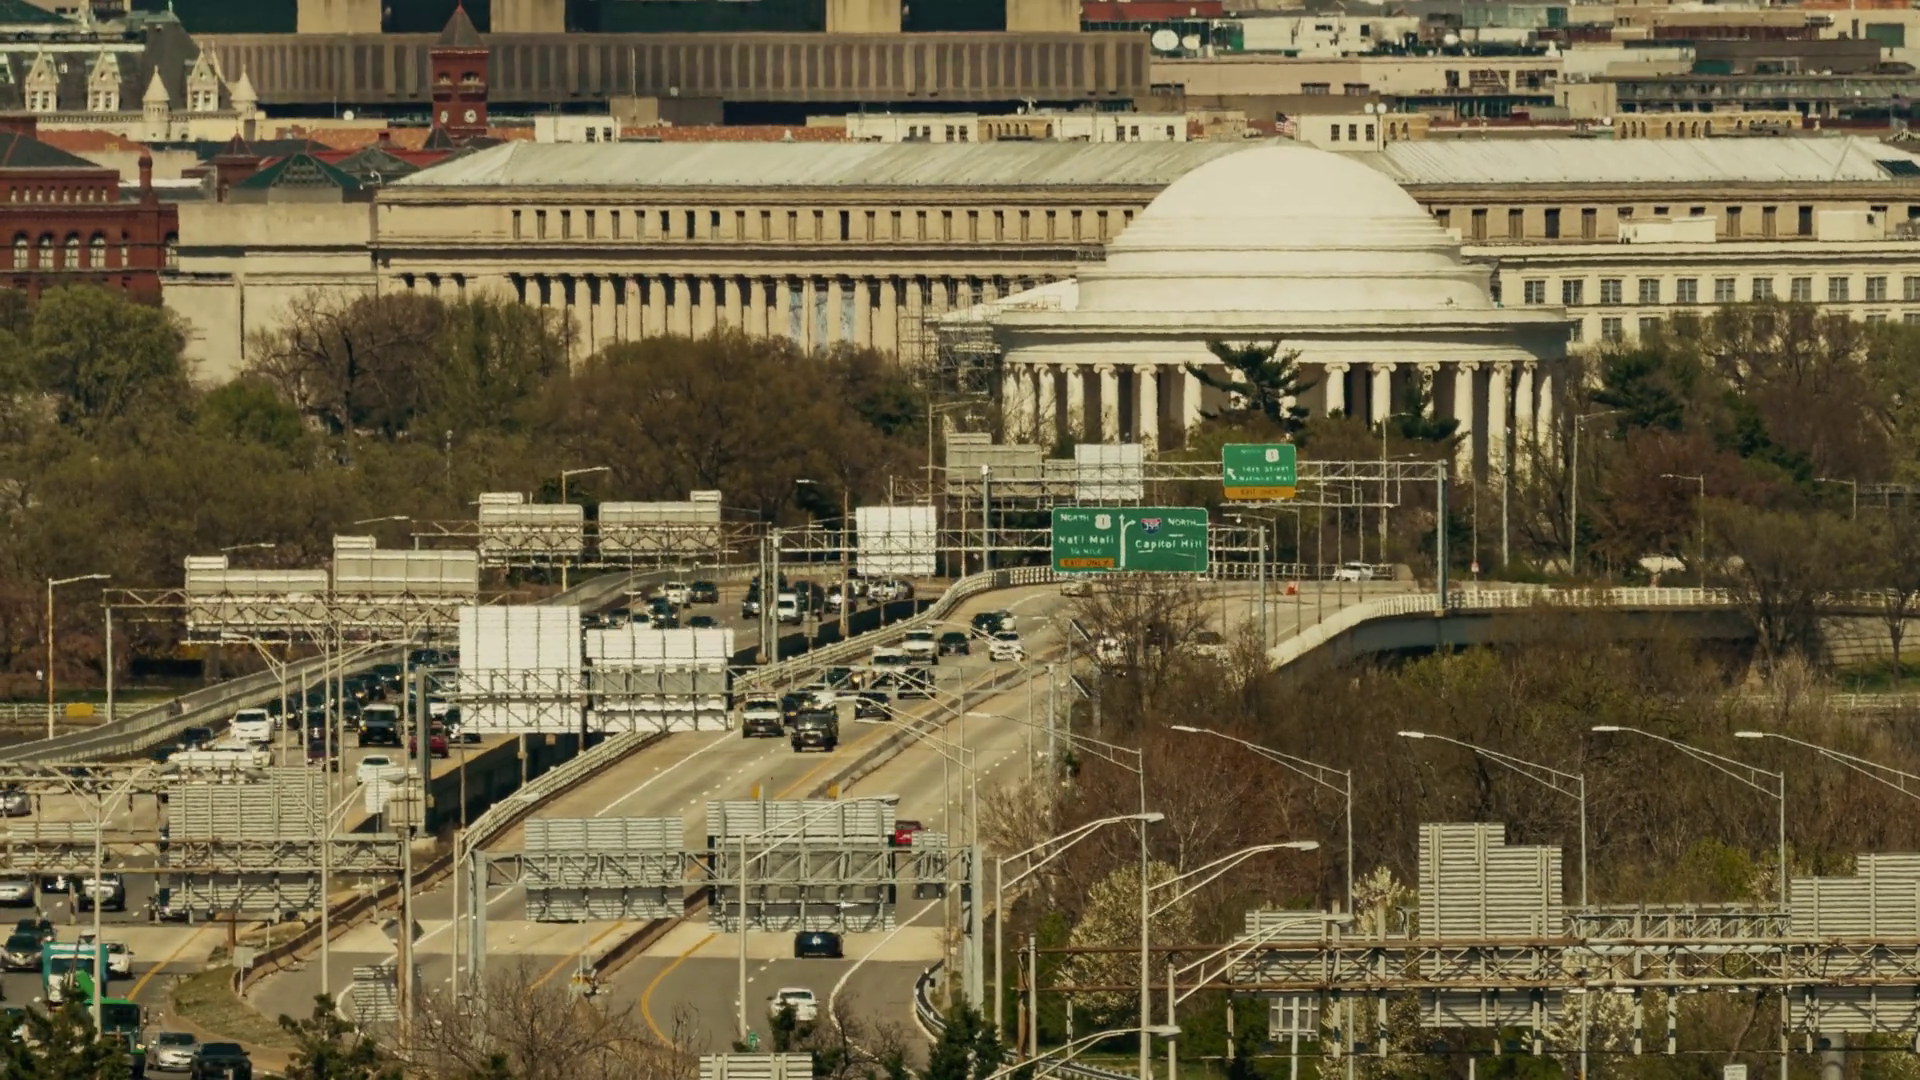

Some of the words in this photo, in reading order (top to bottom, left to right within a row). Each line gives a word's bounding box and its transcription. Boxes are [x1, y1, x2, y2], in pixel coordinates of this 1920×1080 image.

[1060, 513, 1090, 522] NORTH
[1167, 518, 1196, 527] NORTH
[1090, 535, 1114, 544] Mall
[1135, 539, 1176, 551] Capitol
[1180, 539, 1202, 548] Hill
